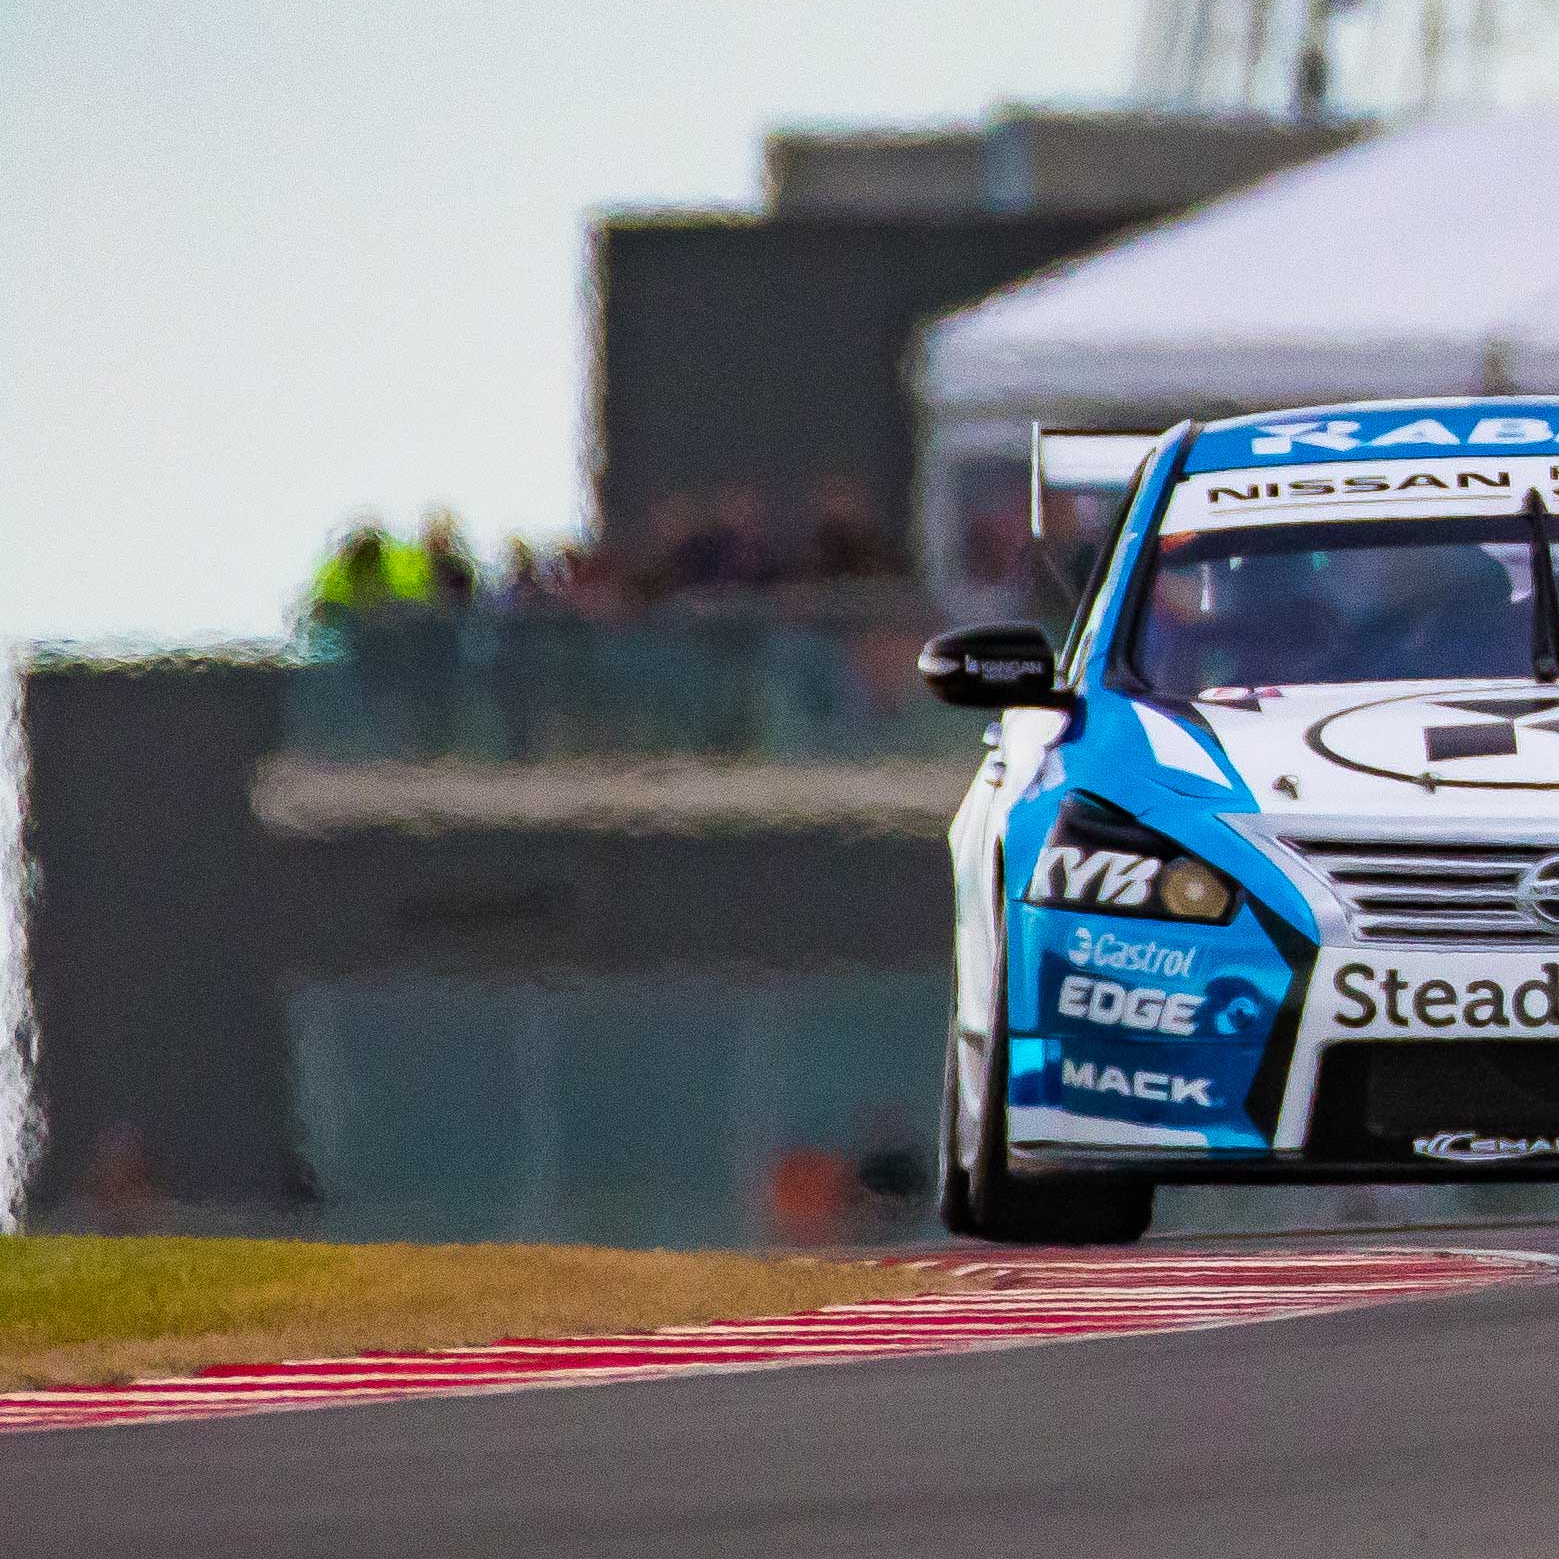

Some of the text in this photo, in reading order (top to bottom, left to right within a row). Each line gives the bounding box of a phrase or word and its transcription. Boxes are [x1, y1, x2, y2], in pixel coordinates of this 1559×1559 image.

[1207, 471, 1510, 504] NISSAN
[1026, 846, 1162, 905] KYB
[1094, 933, 1196, 978] Castrol
[1058, 974, 1207, 1036] EDGE
[1061, 1057, 1212, 1107] MACK
